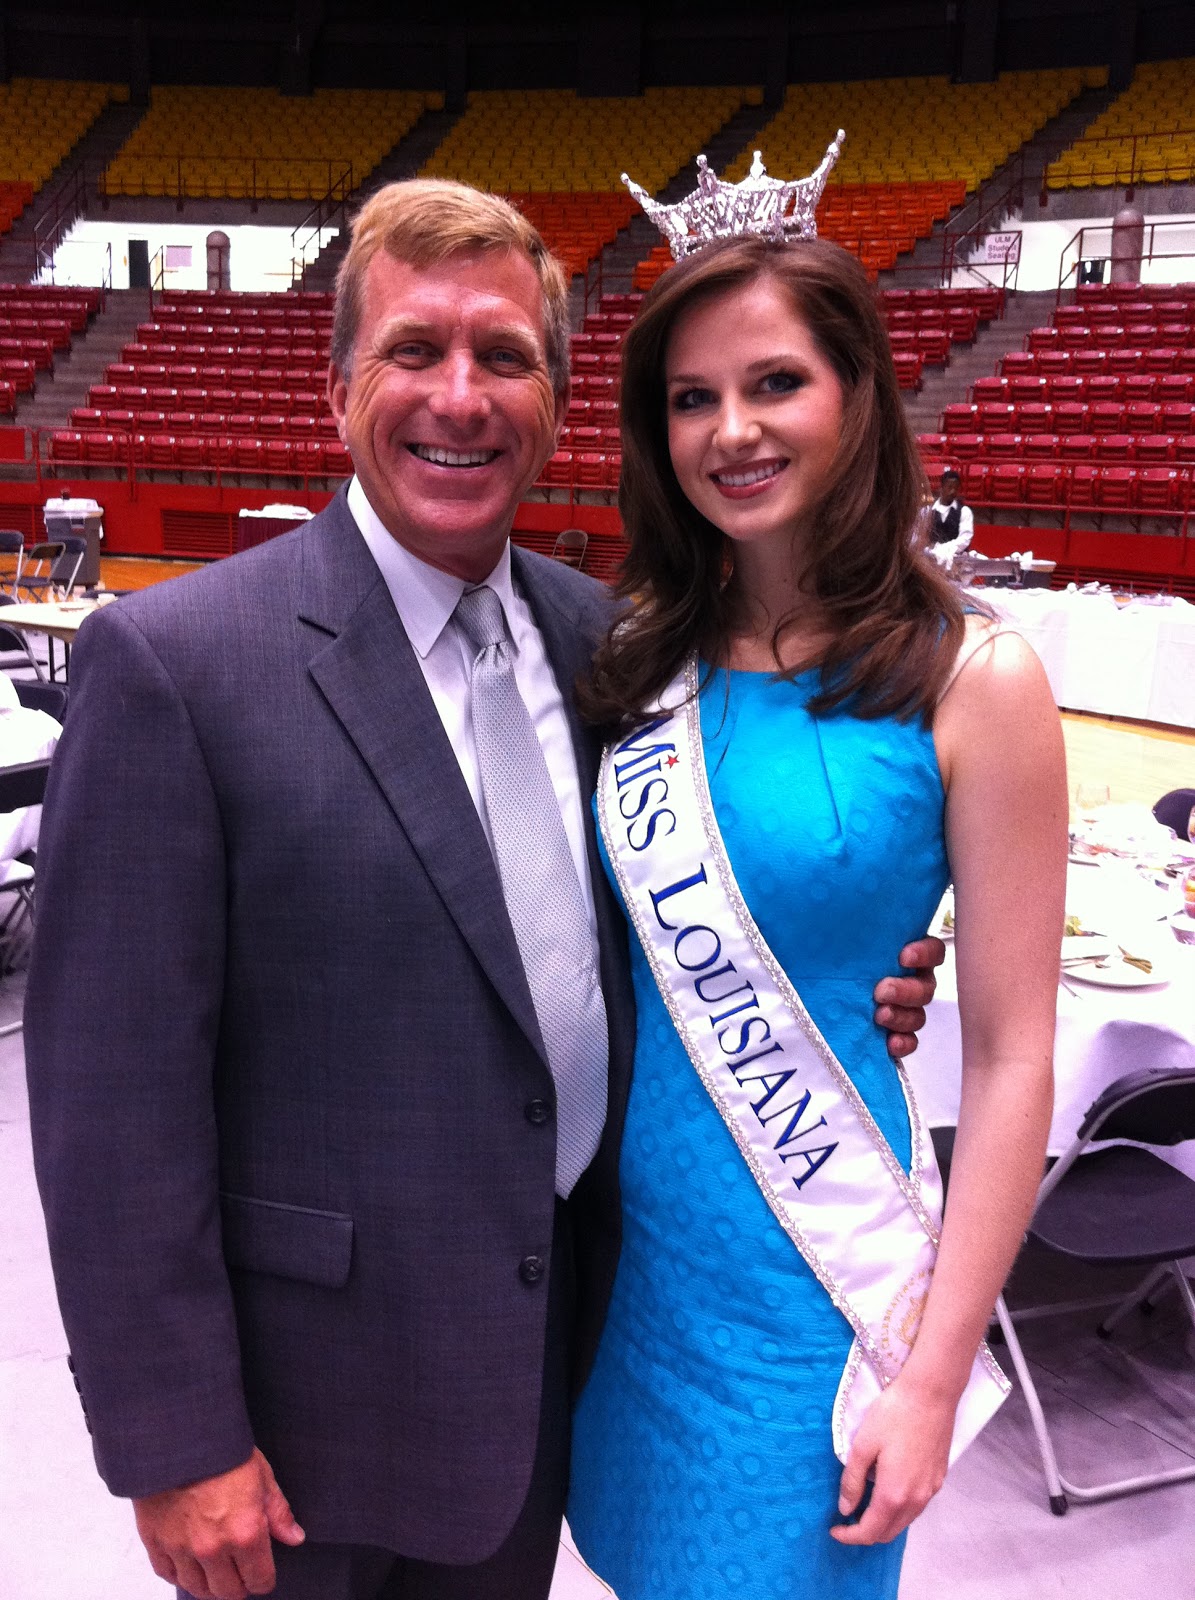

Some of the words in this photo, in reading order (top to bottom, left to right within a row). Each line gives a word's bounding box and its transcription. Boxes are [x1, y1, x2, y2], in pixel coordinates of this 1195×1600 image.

[987, 252, 1016, 260] Seatng
[613, 715, 677, 852] MISS
[648, 862, 840, 1191] LOUISIANA
